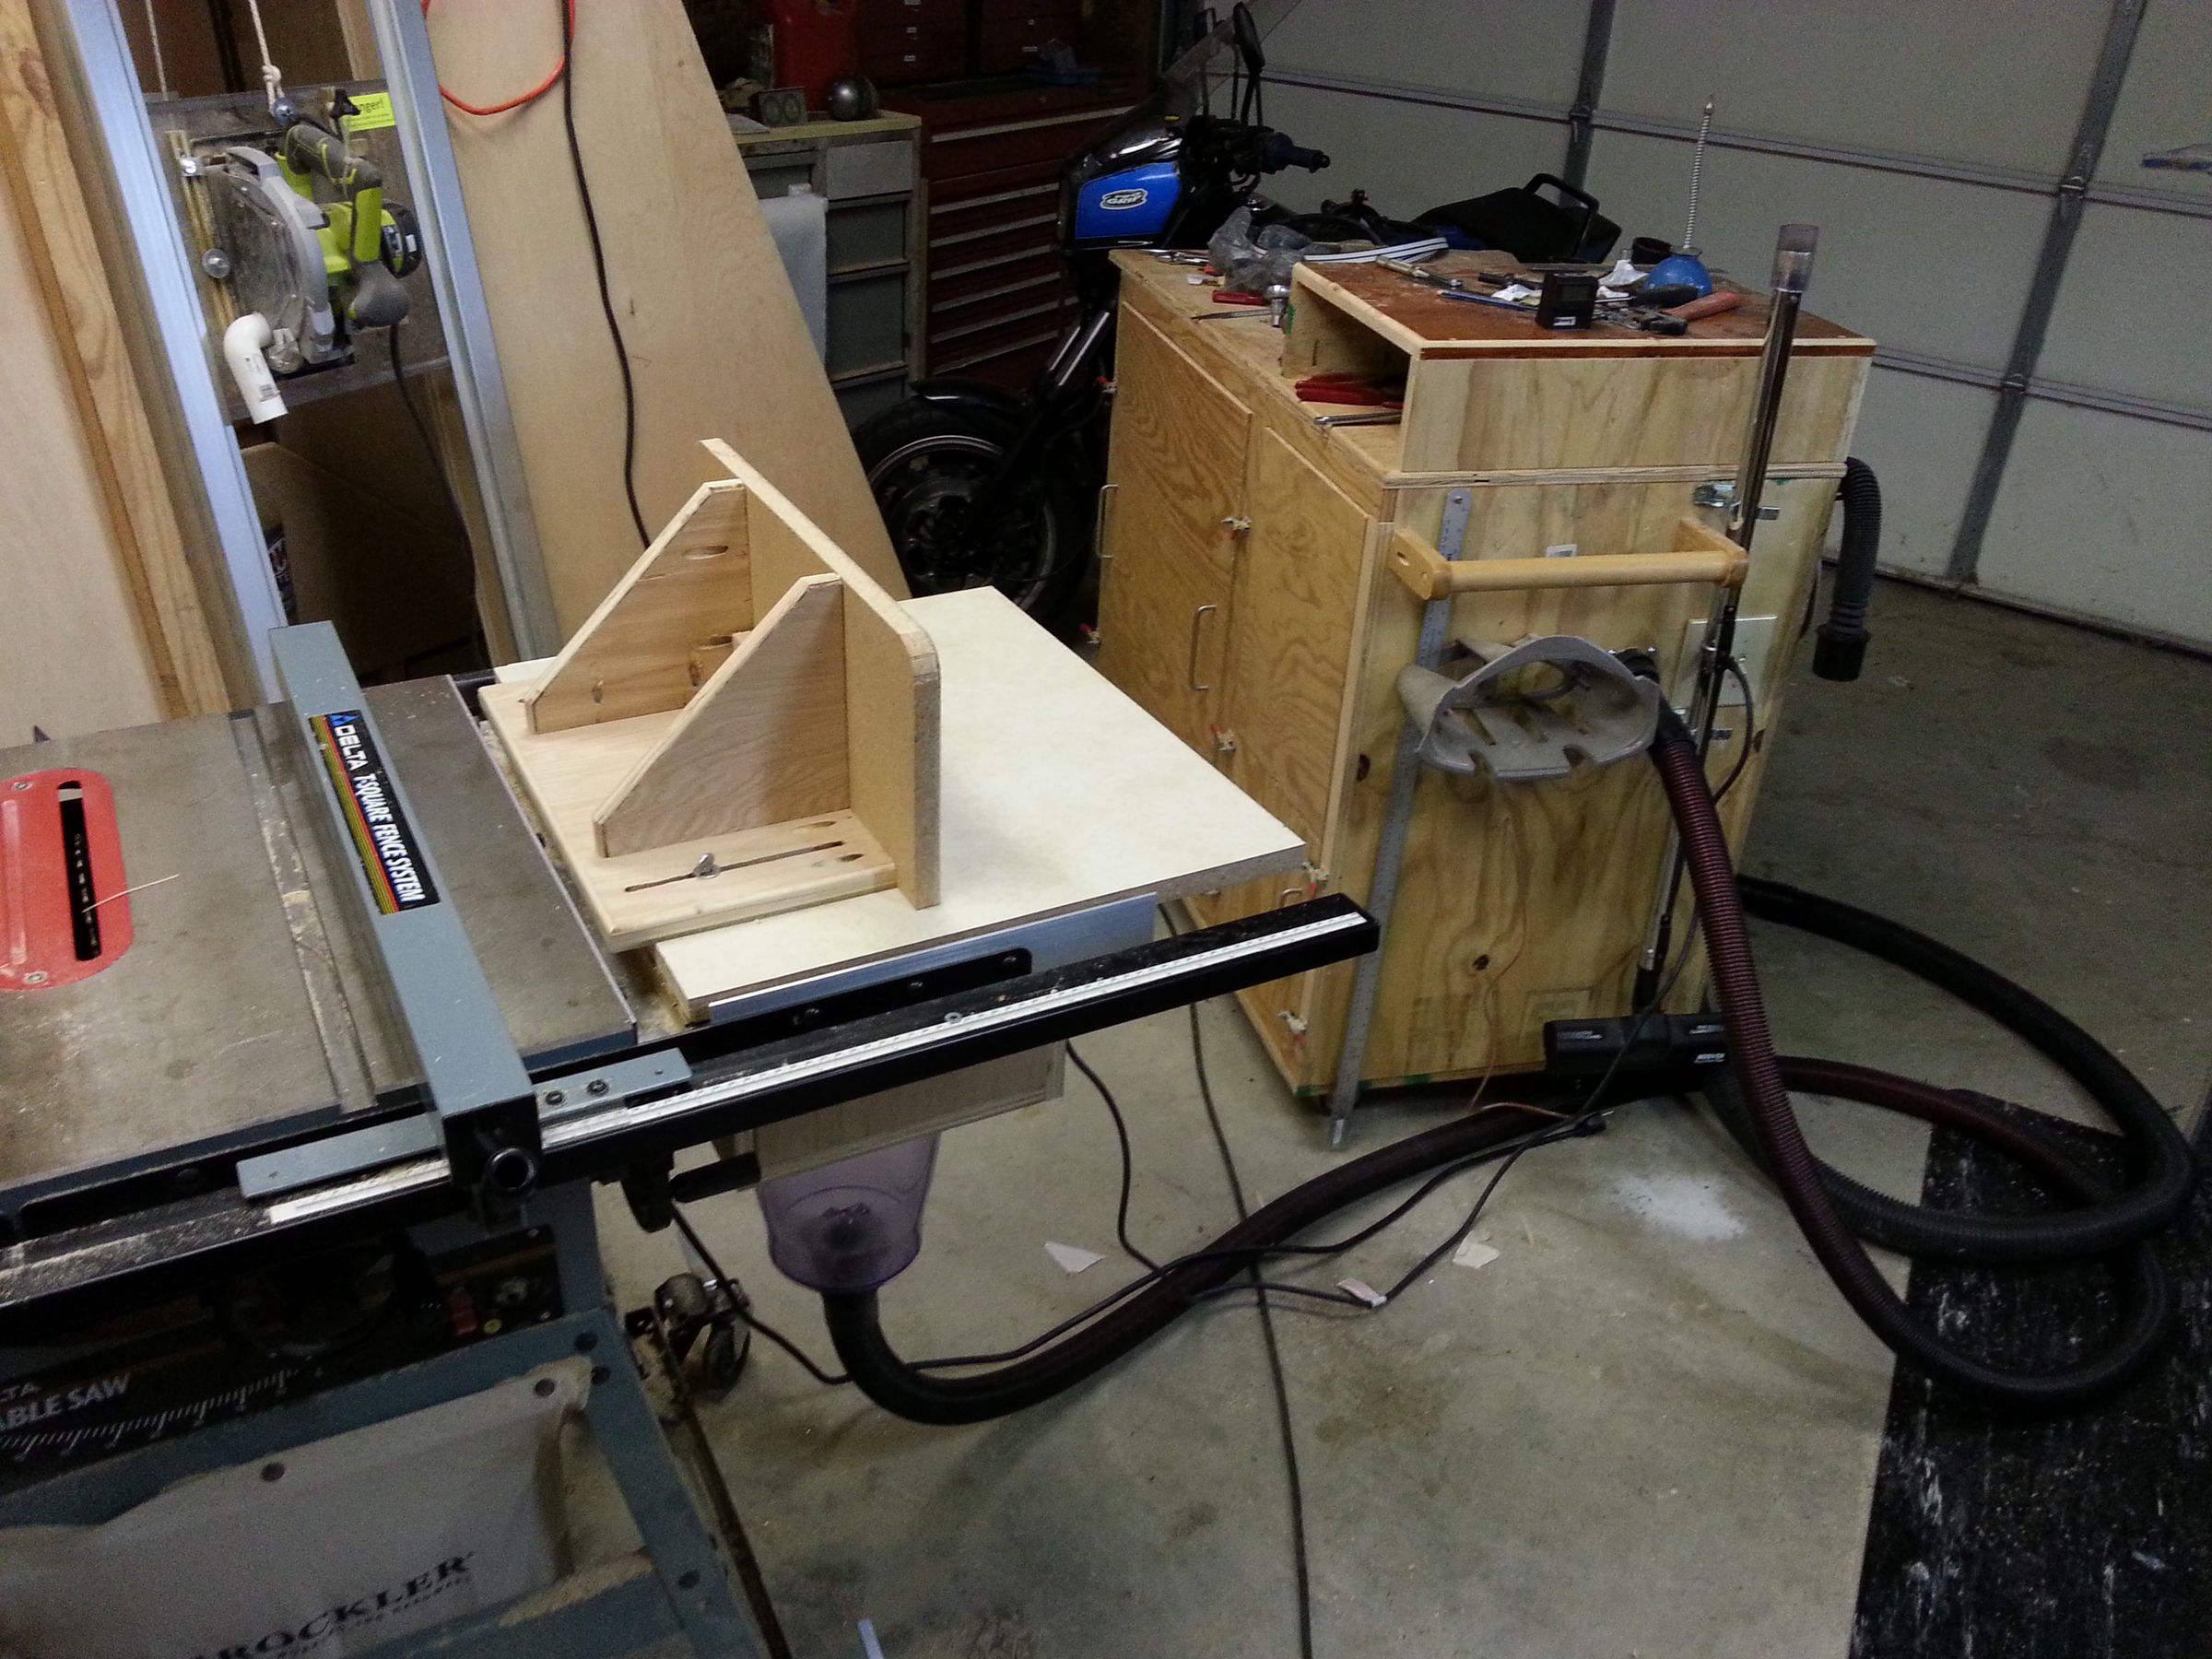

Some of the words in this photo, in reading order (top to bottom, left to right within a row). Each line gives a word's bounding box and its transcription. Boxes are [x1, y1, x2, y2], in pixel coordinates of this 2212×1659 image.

[334, 724, 369, 771] DELTA
[353, 773, 393, 823] T-SQUARE
[372, 822, 407, 858] FENCE
[384, 856, 427, 902] SYSTEM
[67, 1371, 132, 1411] SAW
